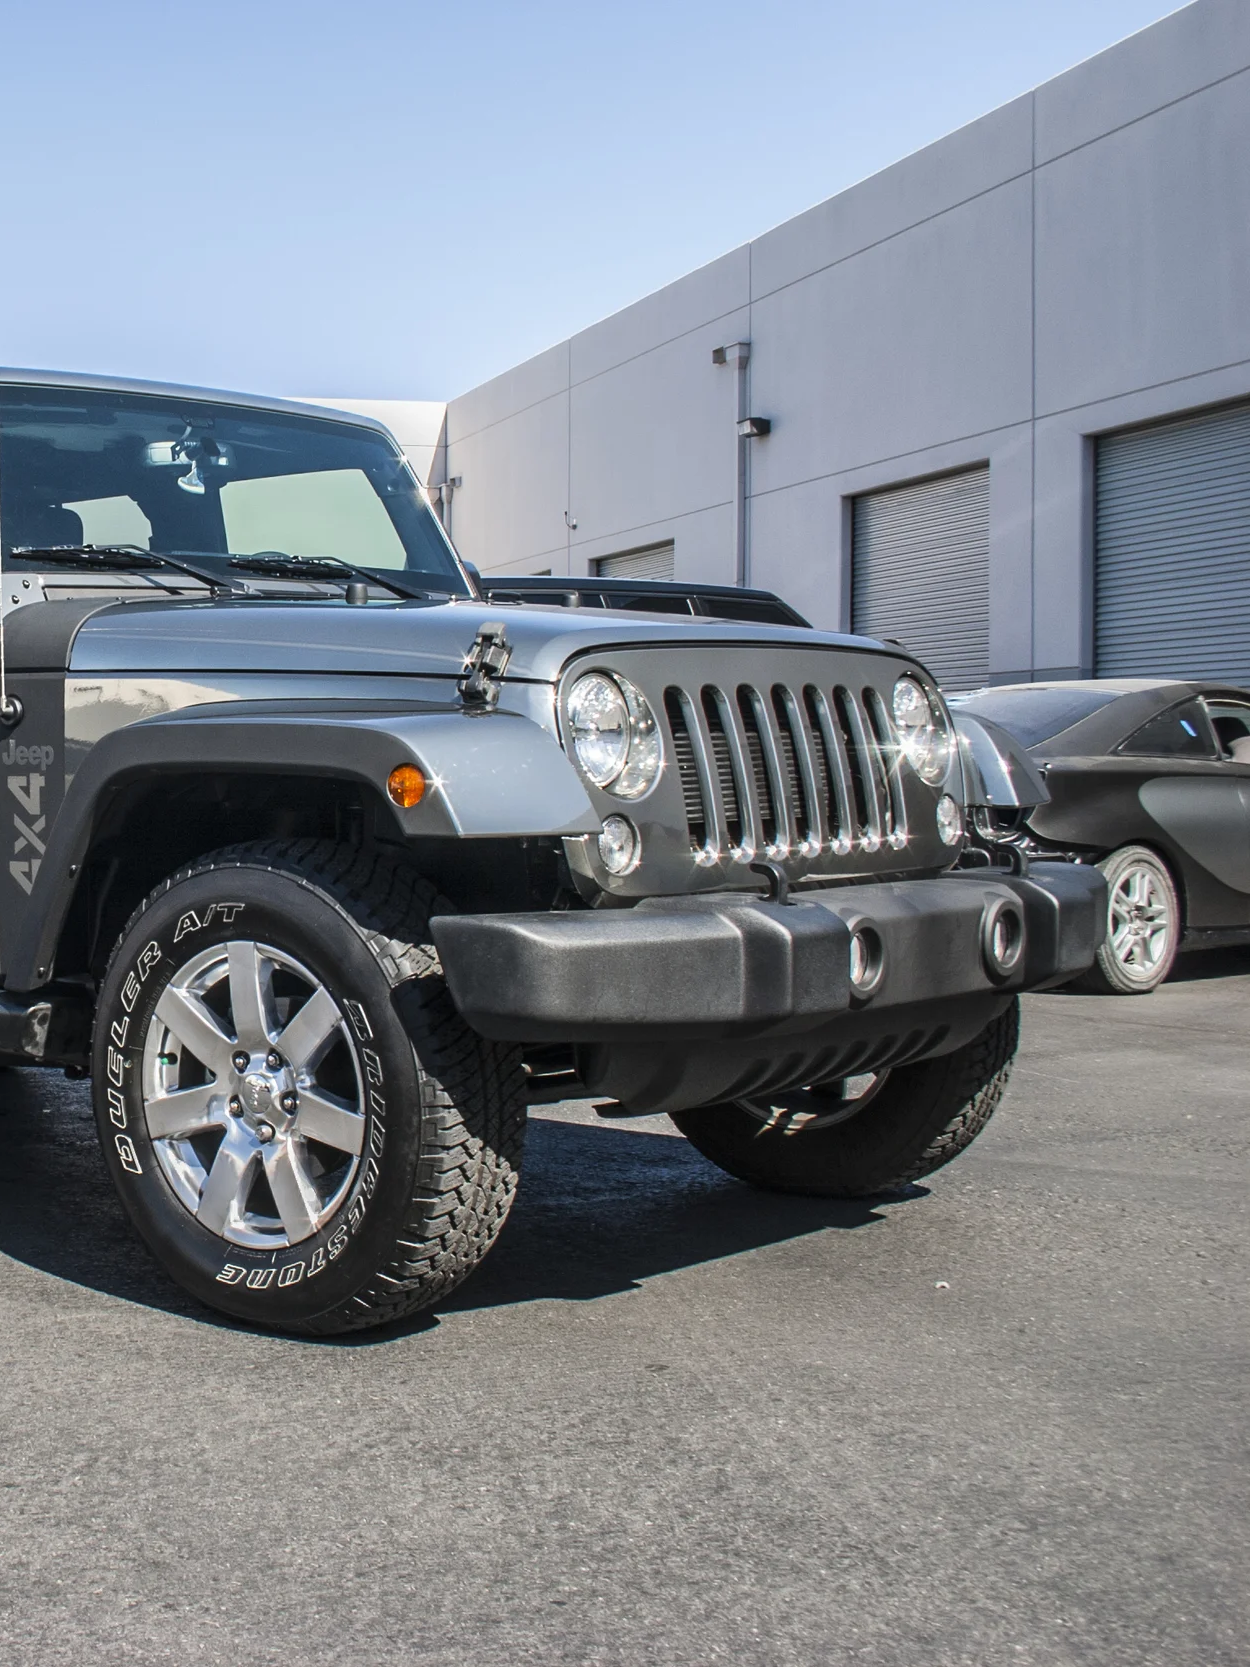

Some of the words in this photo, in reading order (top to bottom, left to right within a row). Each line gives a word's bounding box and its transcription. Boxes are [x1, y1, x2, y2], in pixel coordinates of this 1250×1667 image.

[2, 739, 54, 770] Jeep
[106, 940, 162, 1175] DUELER
[173, 903, 245, 941] A/T
[216, 997, 386, 1289] BRIDGESTONE
